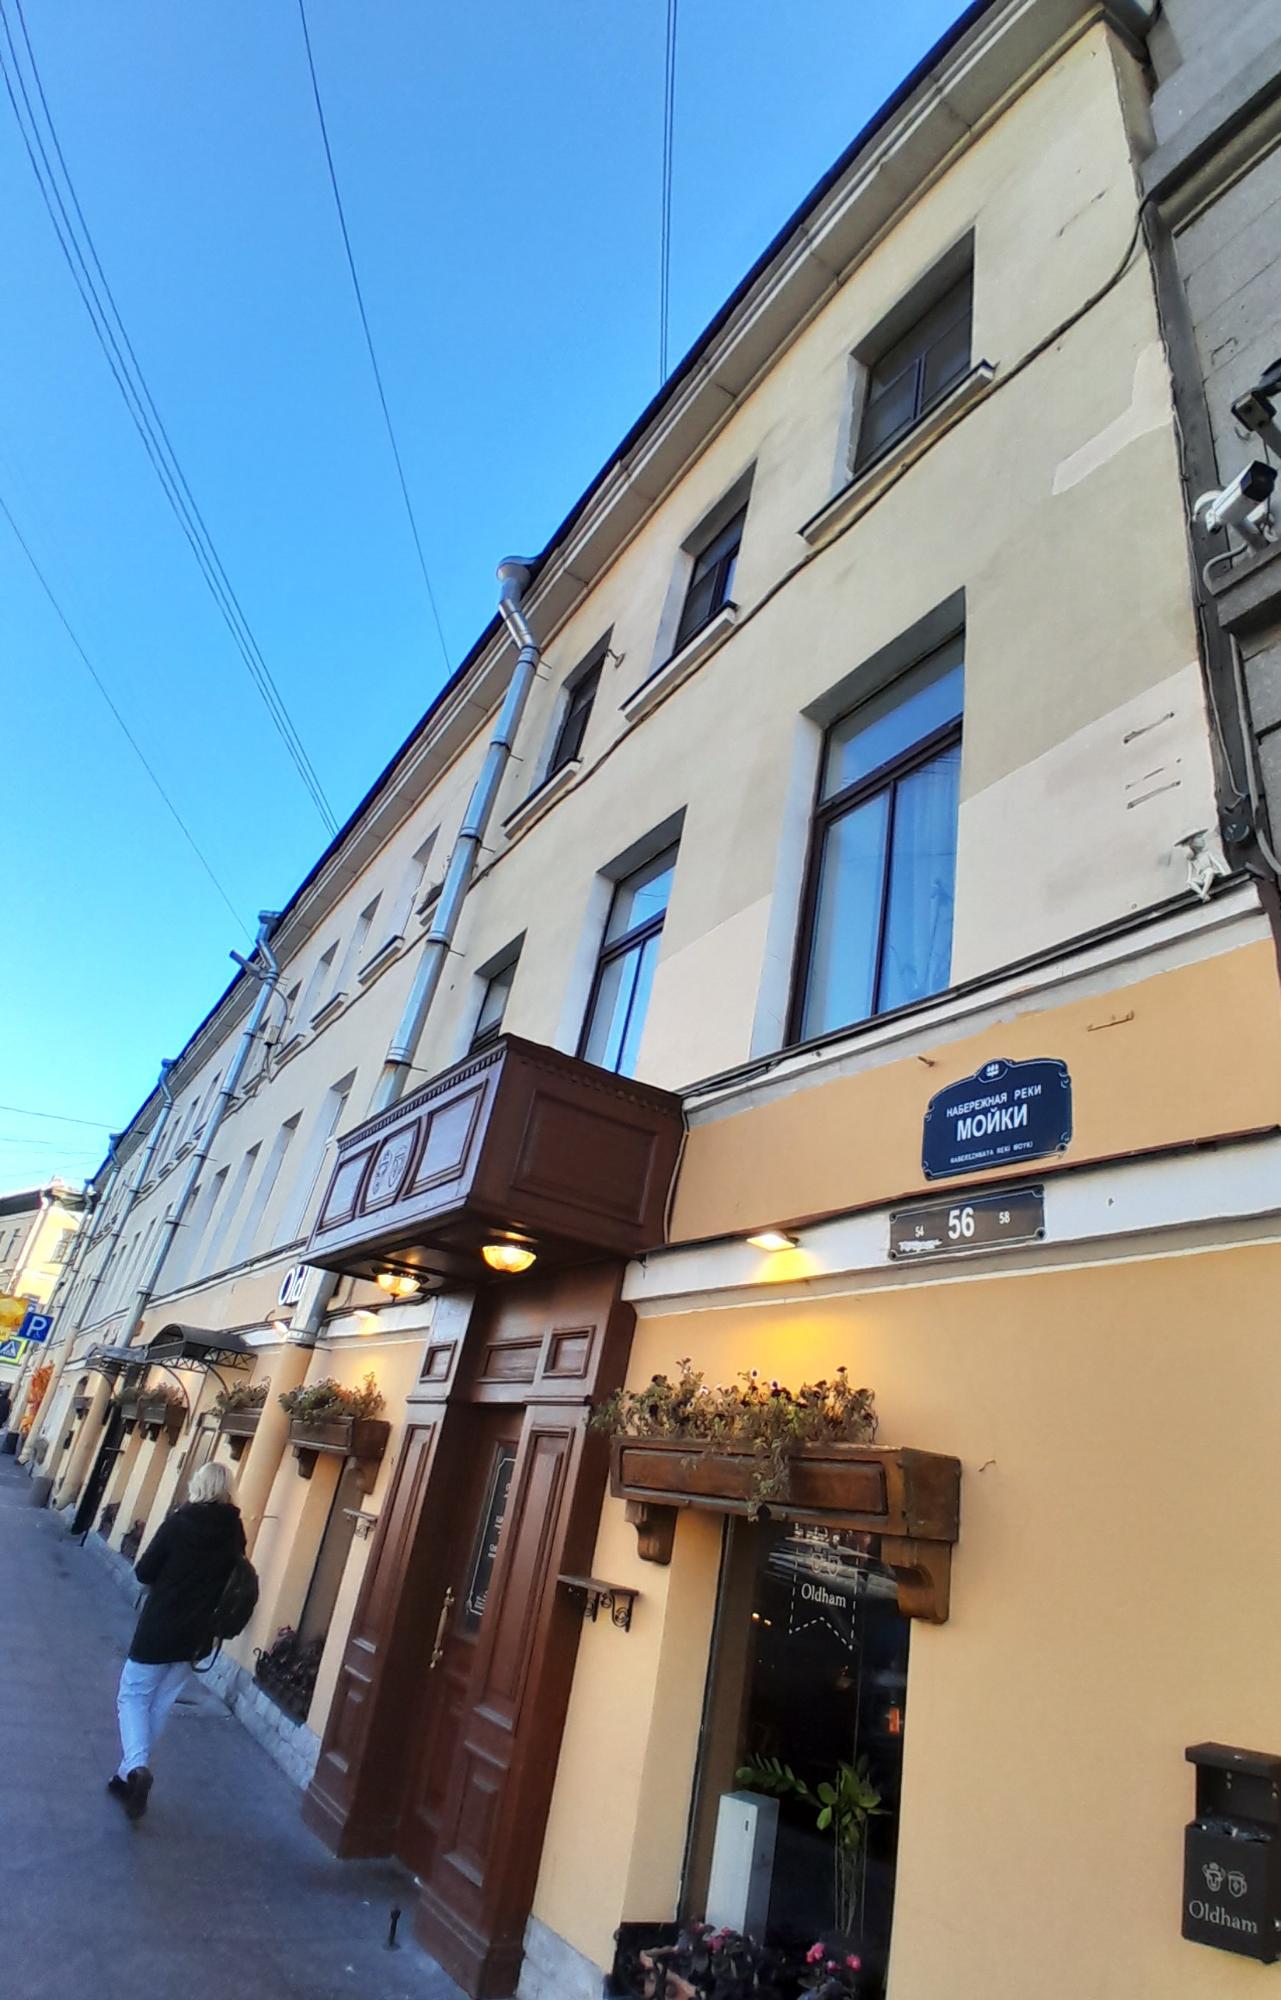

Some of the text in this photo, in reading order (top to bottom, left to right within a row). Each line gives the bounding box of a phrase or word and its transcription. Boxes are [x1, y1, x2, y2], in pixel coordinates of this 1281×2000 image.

[946, 1084, 1042, 1118] НАБЕРЕЖНАЯ РЕКИ
[956, 1103, 1028, 1141] МОЙКИ
[915, 1206, 1011, 1240] 54 56 58
[801, 1583, 847, 1608] Oldham
[1188, 1899, 1259, 1935] Oldham
